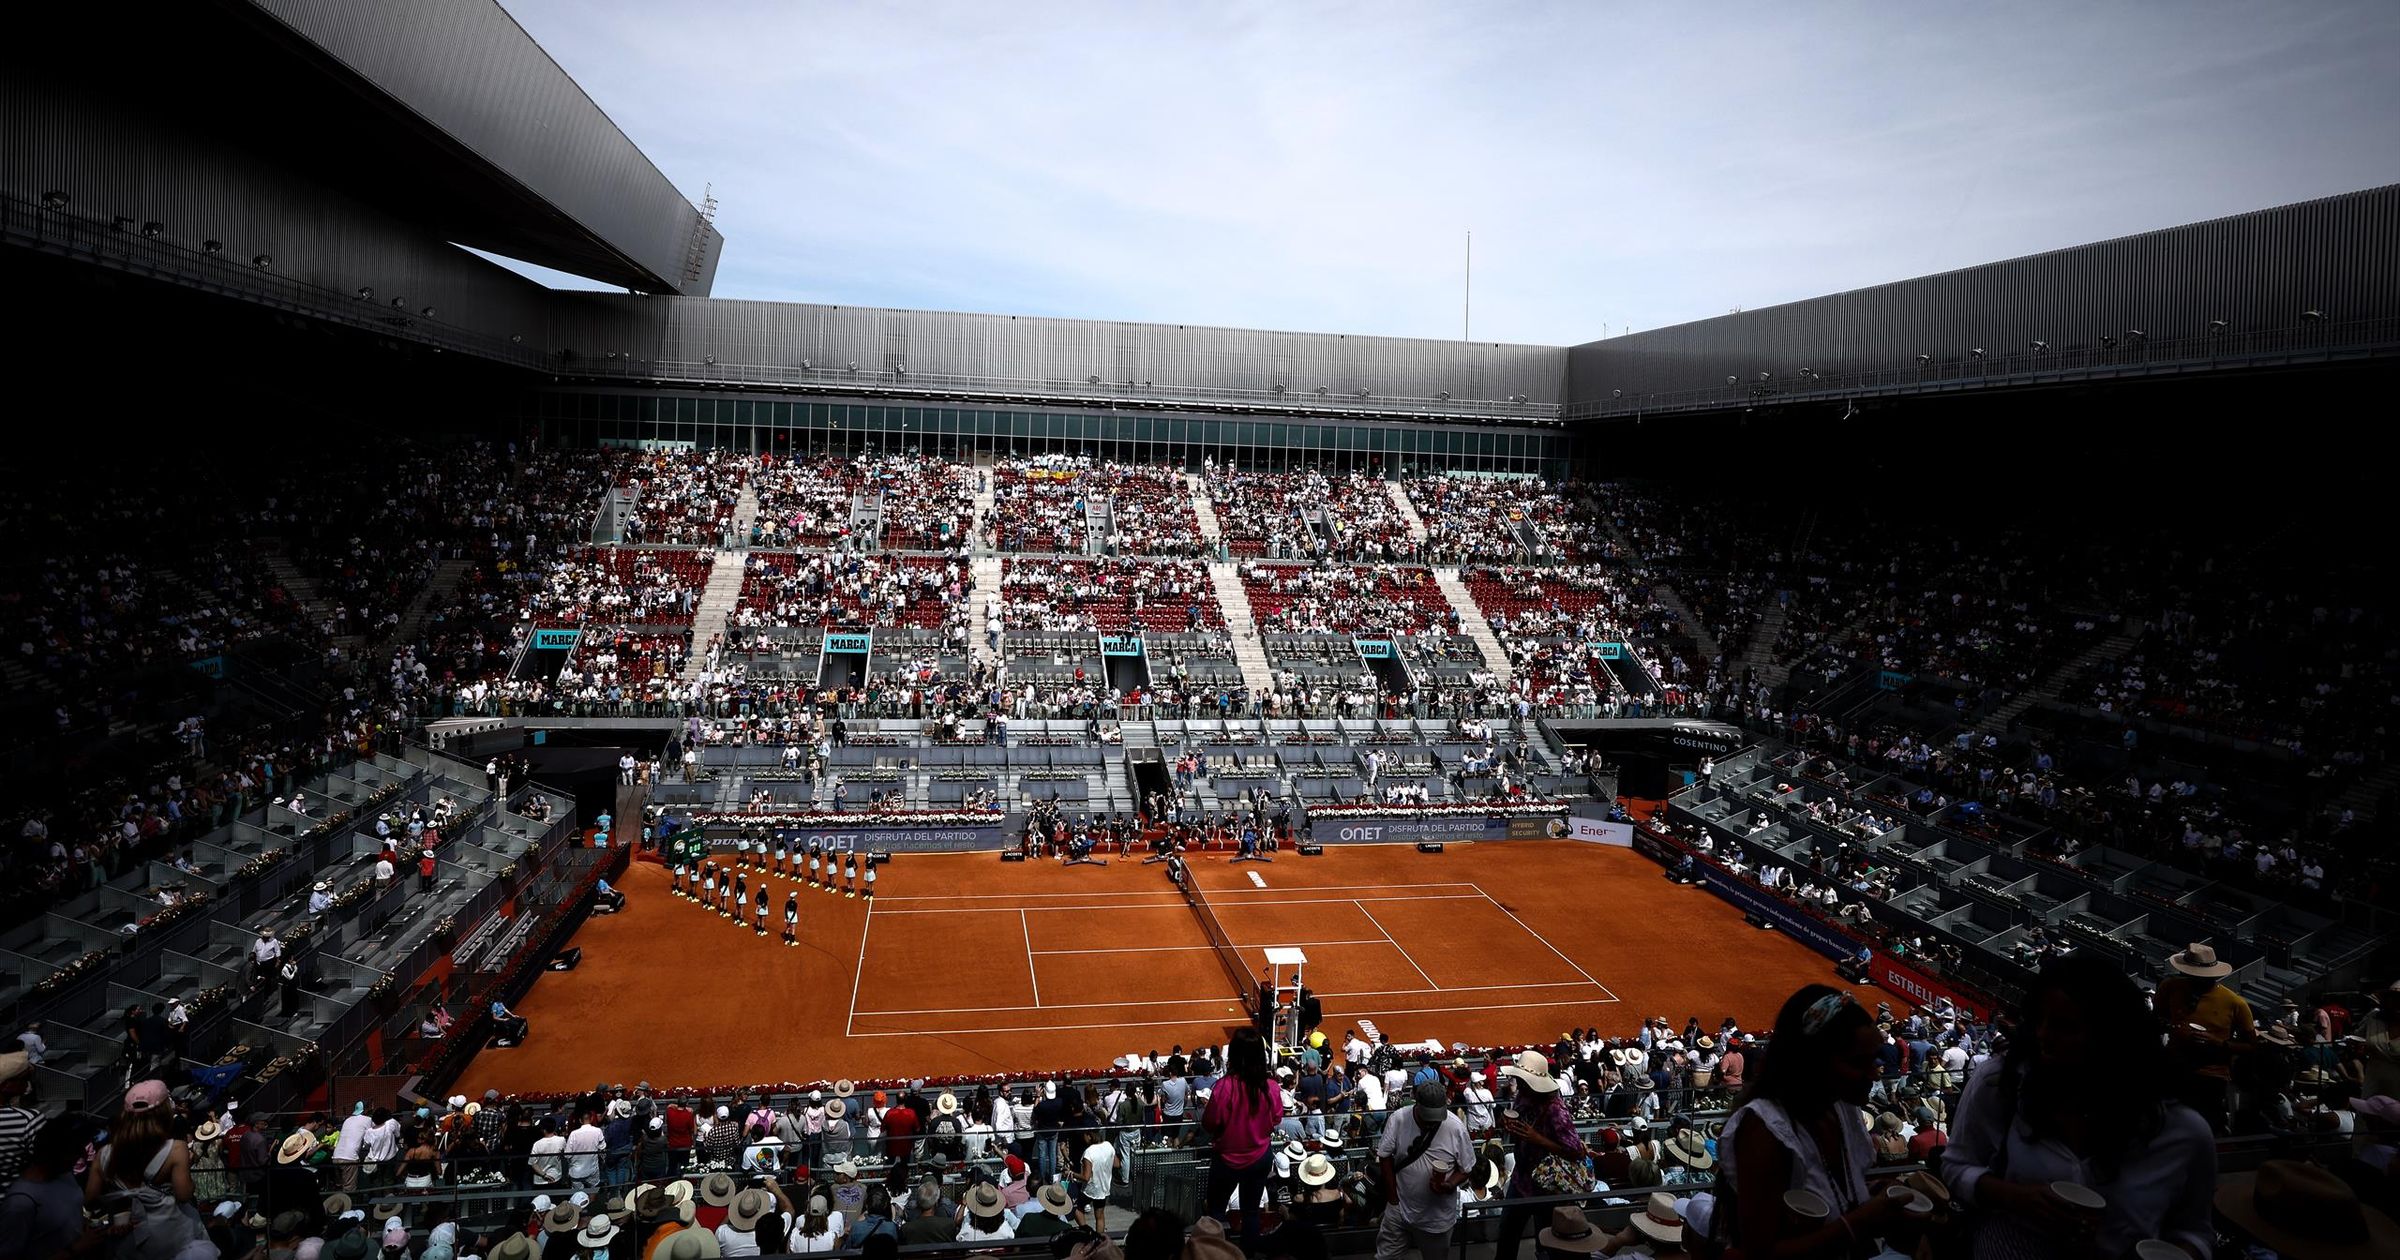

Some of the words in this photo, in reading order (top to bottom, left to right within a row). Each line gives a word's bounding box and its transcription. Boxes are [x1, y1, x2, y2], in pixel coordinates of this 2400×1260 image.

[830, 638, 866, 650] MARCA
[1104, 642, 1137, 652] MARCA
[1674, 737, 1727, 752] COSENTINO
[864, 833, 912, 841] DISFRUTA
[914, 832, 930, 841] DEL
[934, 832, 976, 840] PARTIDO
[1888, 970, 1942, 1010] ESTRELLA
